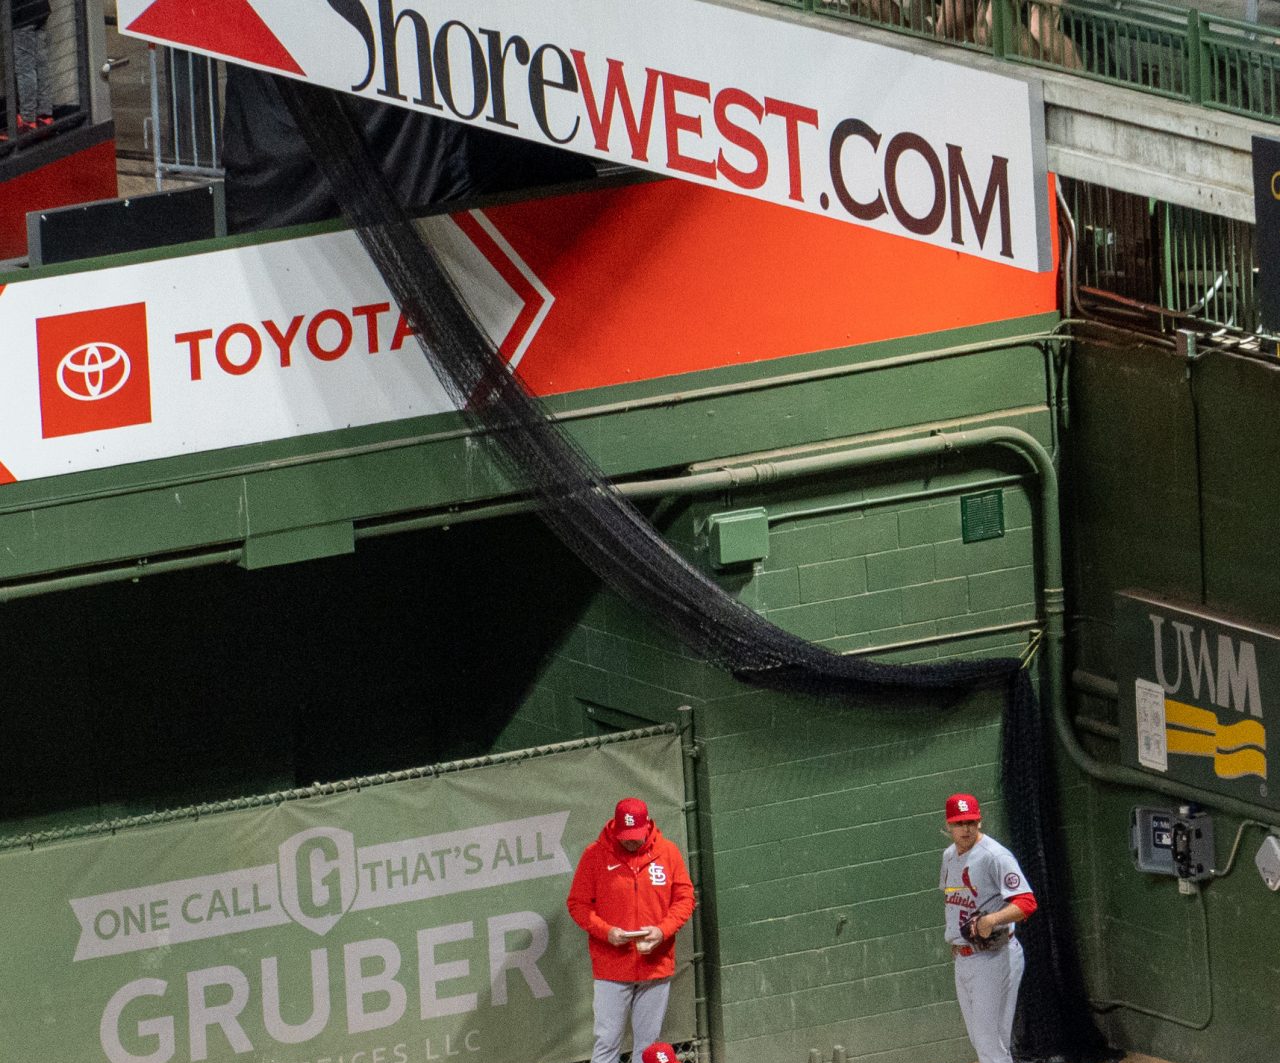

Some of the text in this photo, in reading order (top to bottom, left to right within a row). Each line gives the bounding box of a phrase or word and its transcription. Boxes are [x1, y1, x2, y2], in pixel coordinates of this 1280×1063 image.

[1150, 614, 1263, 719] UWM
[94, 900, 169, 941] ONE
[181, 883, 272, 925] CALL
[294, 836, 343, 920] G
[491, 829, 555, 867] ALL
[425, 1029, 482, 1060] LLC
